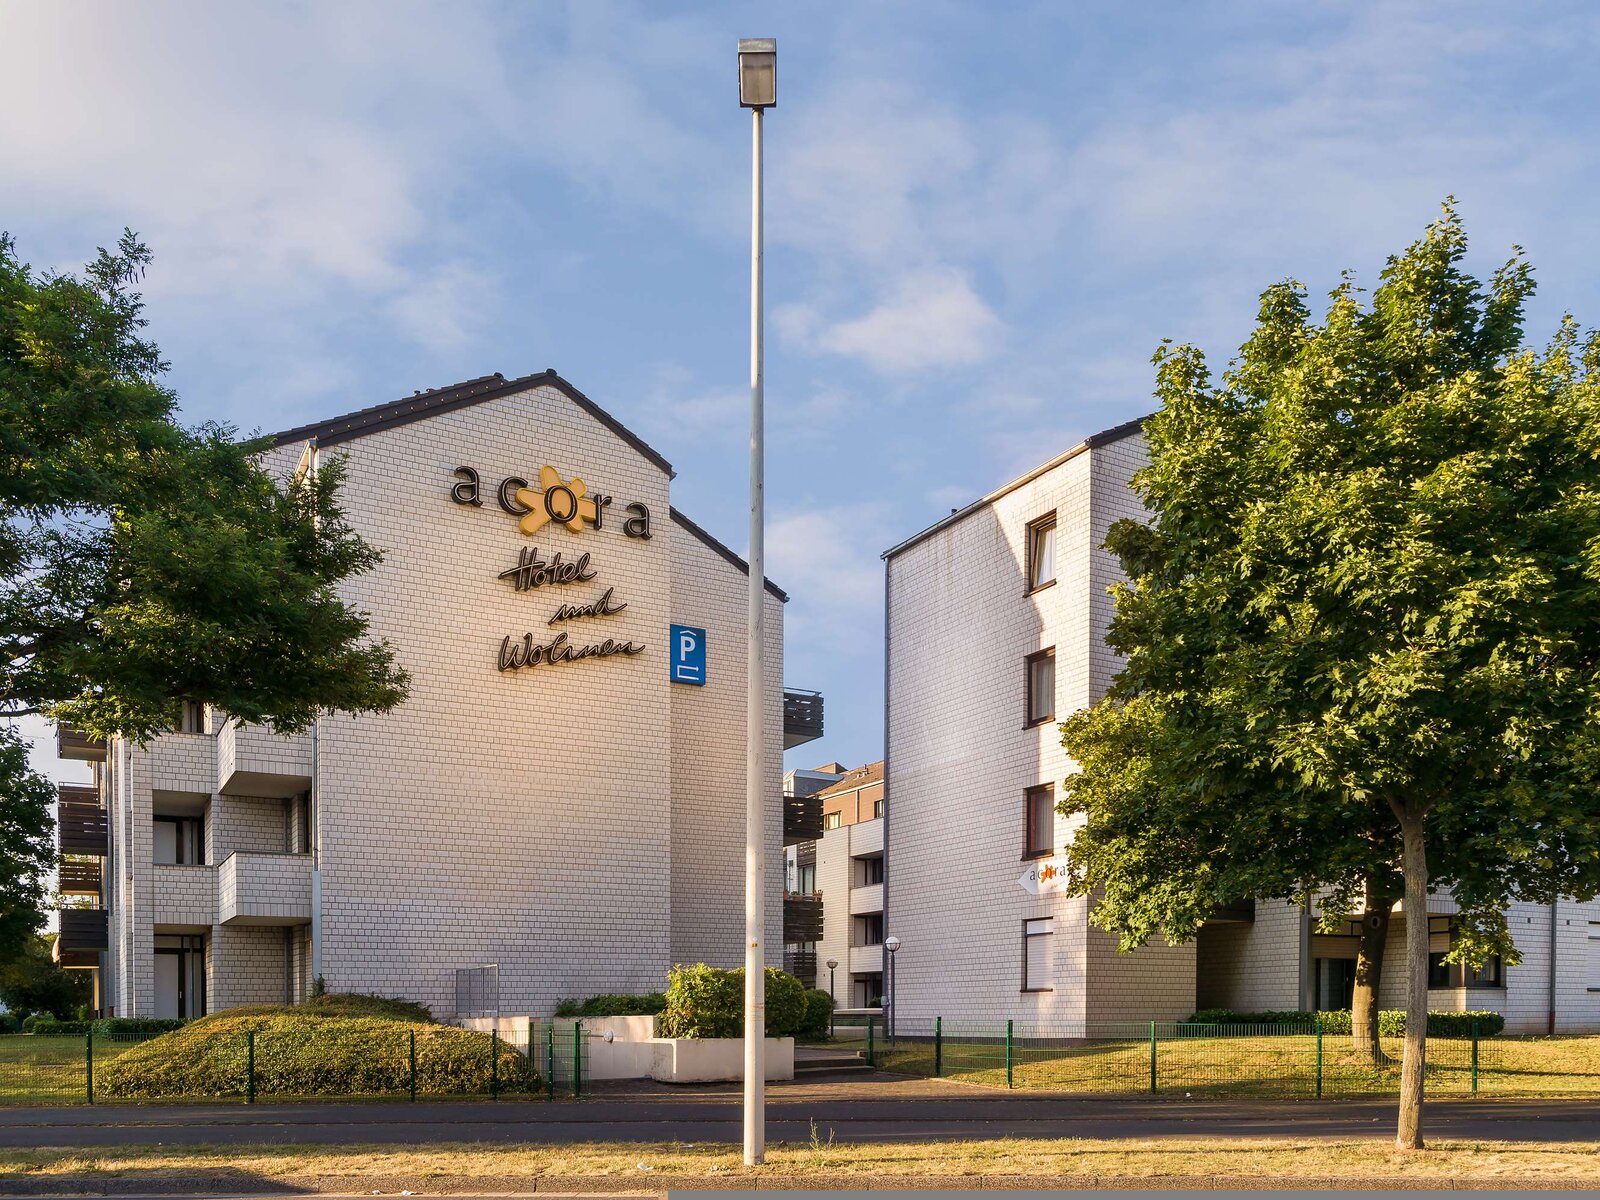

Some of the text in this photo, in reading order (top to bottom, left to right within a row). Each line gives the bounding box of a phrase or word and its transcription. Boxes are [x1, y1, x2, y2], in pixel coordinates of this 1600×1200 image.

[451, 465, 653, 540] acora
[498, 546, 597, 591] Hotel
[548, 587, 627, 625] und
[498, 632, 645, 672] Wohnen
[680, 635, 696, 661] P
